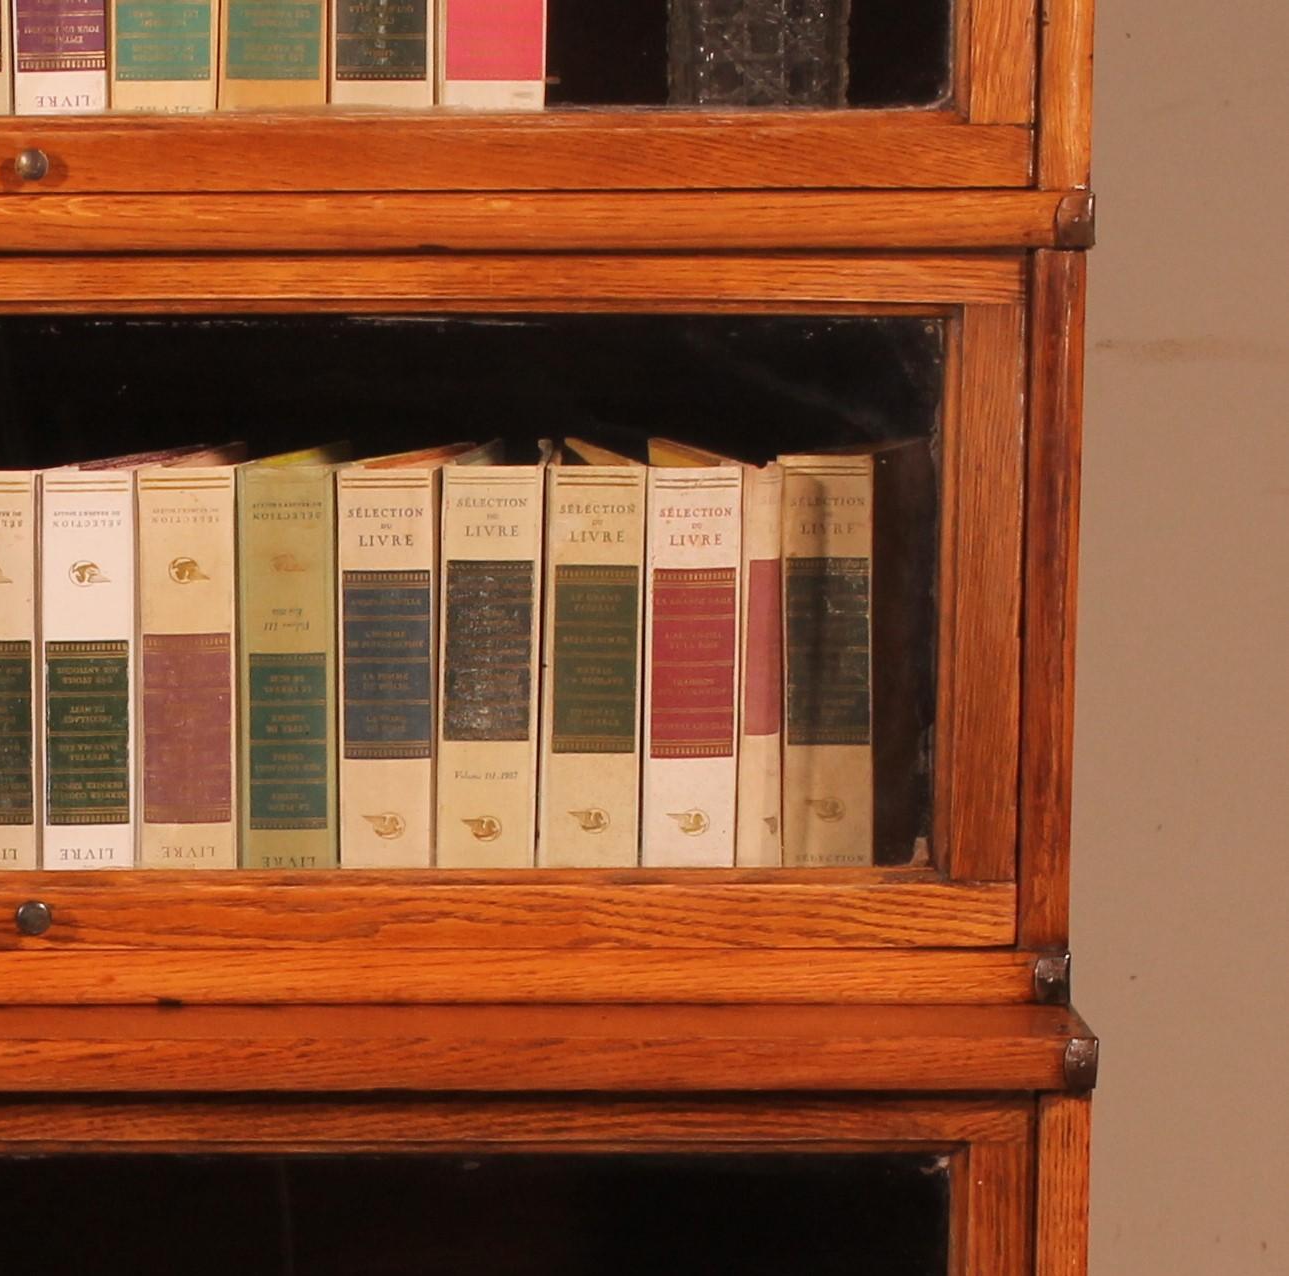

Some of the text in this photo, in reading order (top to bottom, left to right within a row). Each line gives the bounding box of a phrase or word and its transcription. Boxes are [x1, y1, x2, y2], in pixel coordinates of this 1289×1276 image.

[35, 95, 90, 108] LIVRE
[456, 496, 528, 508] SÉLECTION
[559, 502, 636, 514] SÉLECTION
[347, 506, 424, 518] SÉLECTION
[659, 505, 732, 518] SÉLECTION
[465, 525, 519, 537] LIVRE
[570, 531, 625, 543] LIVRE
[359, 534, 415, 548] LIVRE
[670, 534, 723, 546] LIVRE
[60, 848, 114, 860] LIVRE
[162, 846, 215, 859] LIVRE
[262, 856, 316, 868] LIVRE
